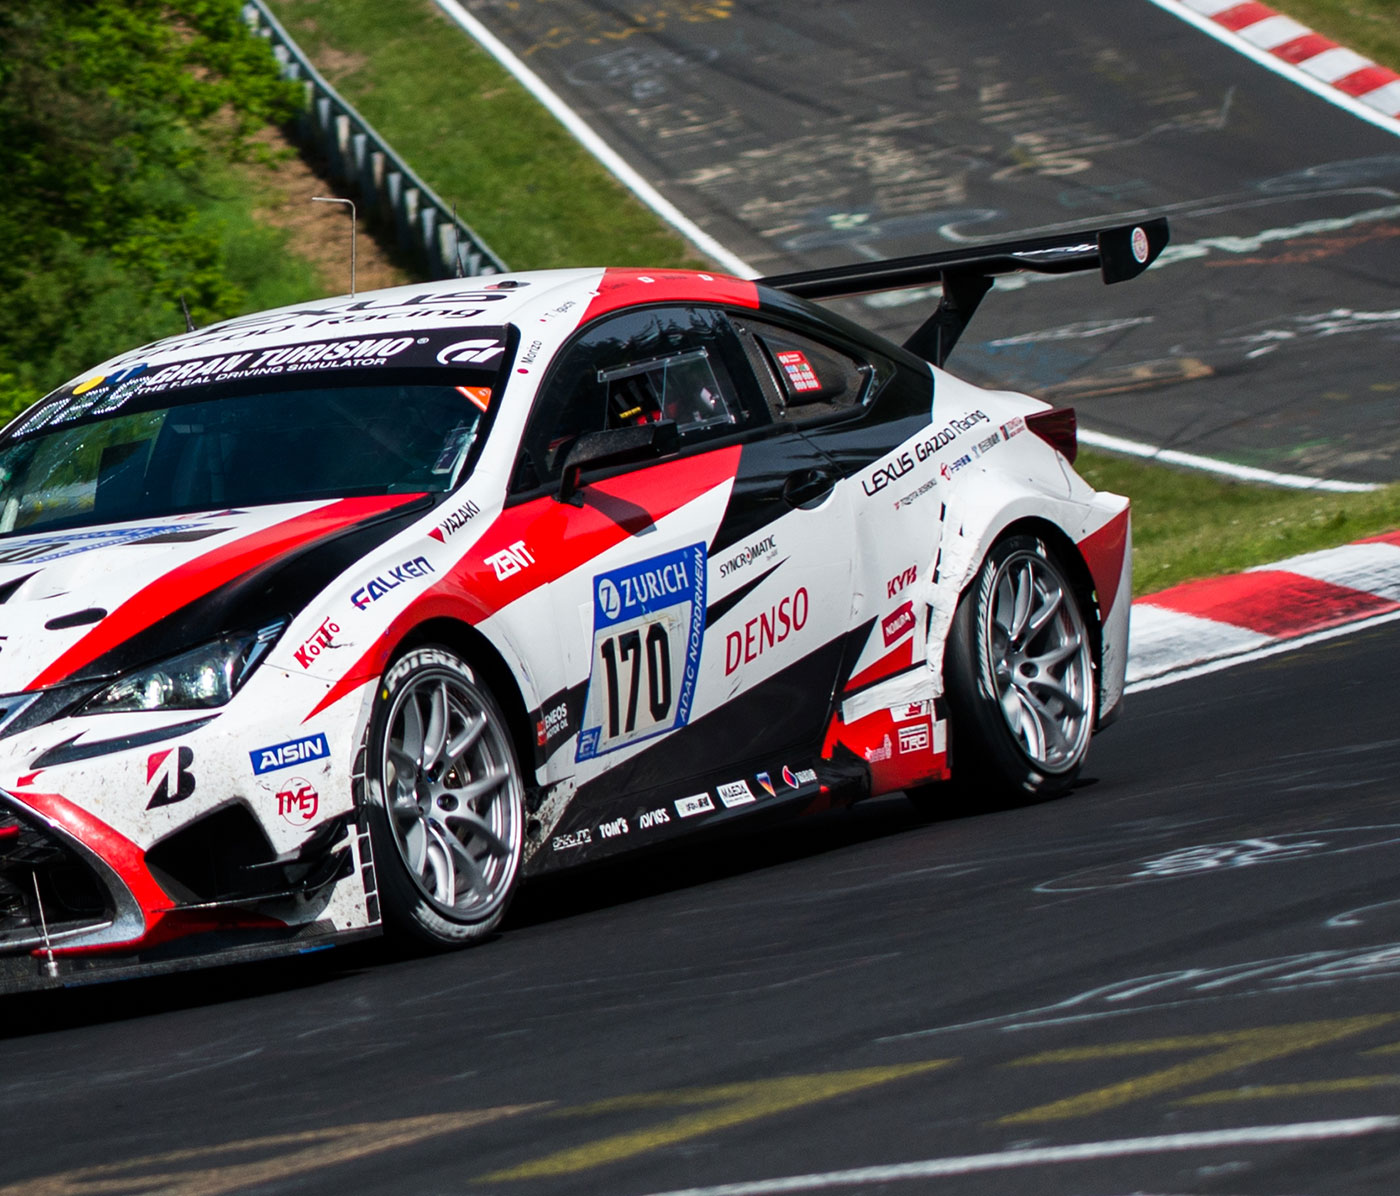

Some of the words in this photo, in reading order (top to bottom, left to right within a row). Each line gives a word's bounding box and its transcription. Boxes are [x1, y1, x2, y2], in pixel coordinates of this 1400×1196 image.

[304, 306, 488, 329] Racing
[149, 352, 253, 385] GRAN
[250, 336, 416, 368] TURISMO
[520, 339, 543, 365] Morizo
[137, 382, 166, 395] THE
[216, 364, 282, 381] DRIVING
[286, 356, 387, 372] SIMULATOR
[862, 452, 915, 497] LEXUS
[915, 428, 957, 463] GAZOO
[949, 409, 991, 438] Racing
[439, 499, 481, 536] YAZAKI
[483, 540, 536, 582] ZENT
[350, 555, 435, 611] FALKEN
[620, 561, 690, 608] ZURICH
[887, 565, 918, 600] KYB
[679, 664, 695, 723] ADAC
[688, 546, 704, 663] NORDRHEIN
[724, 586, 809, 677] DENSO
[600, 622, 673, 739] 170
[259, 737, 323, 770] AISIN
[599, 817, 629, 839] TOM'S
